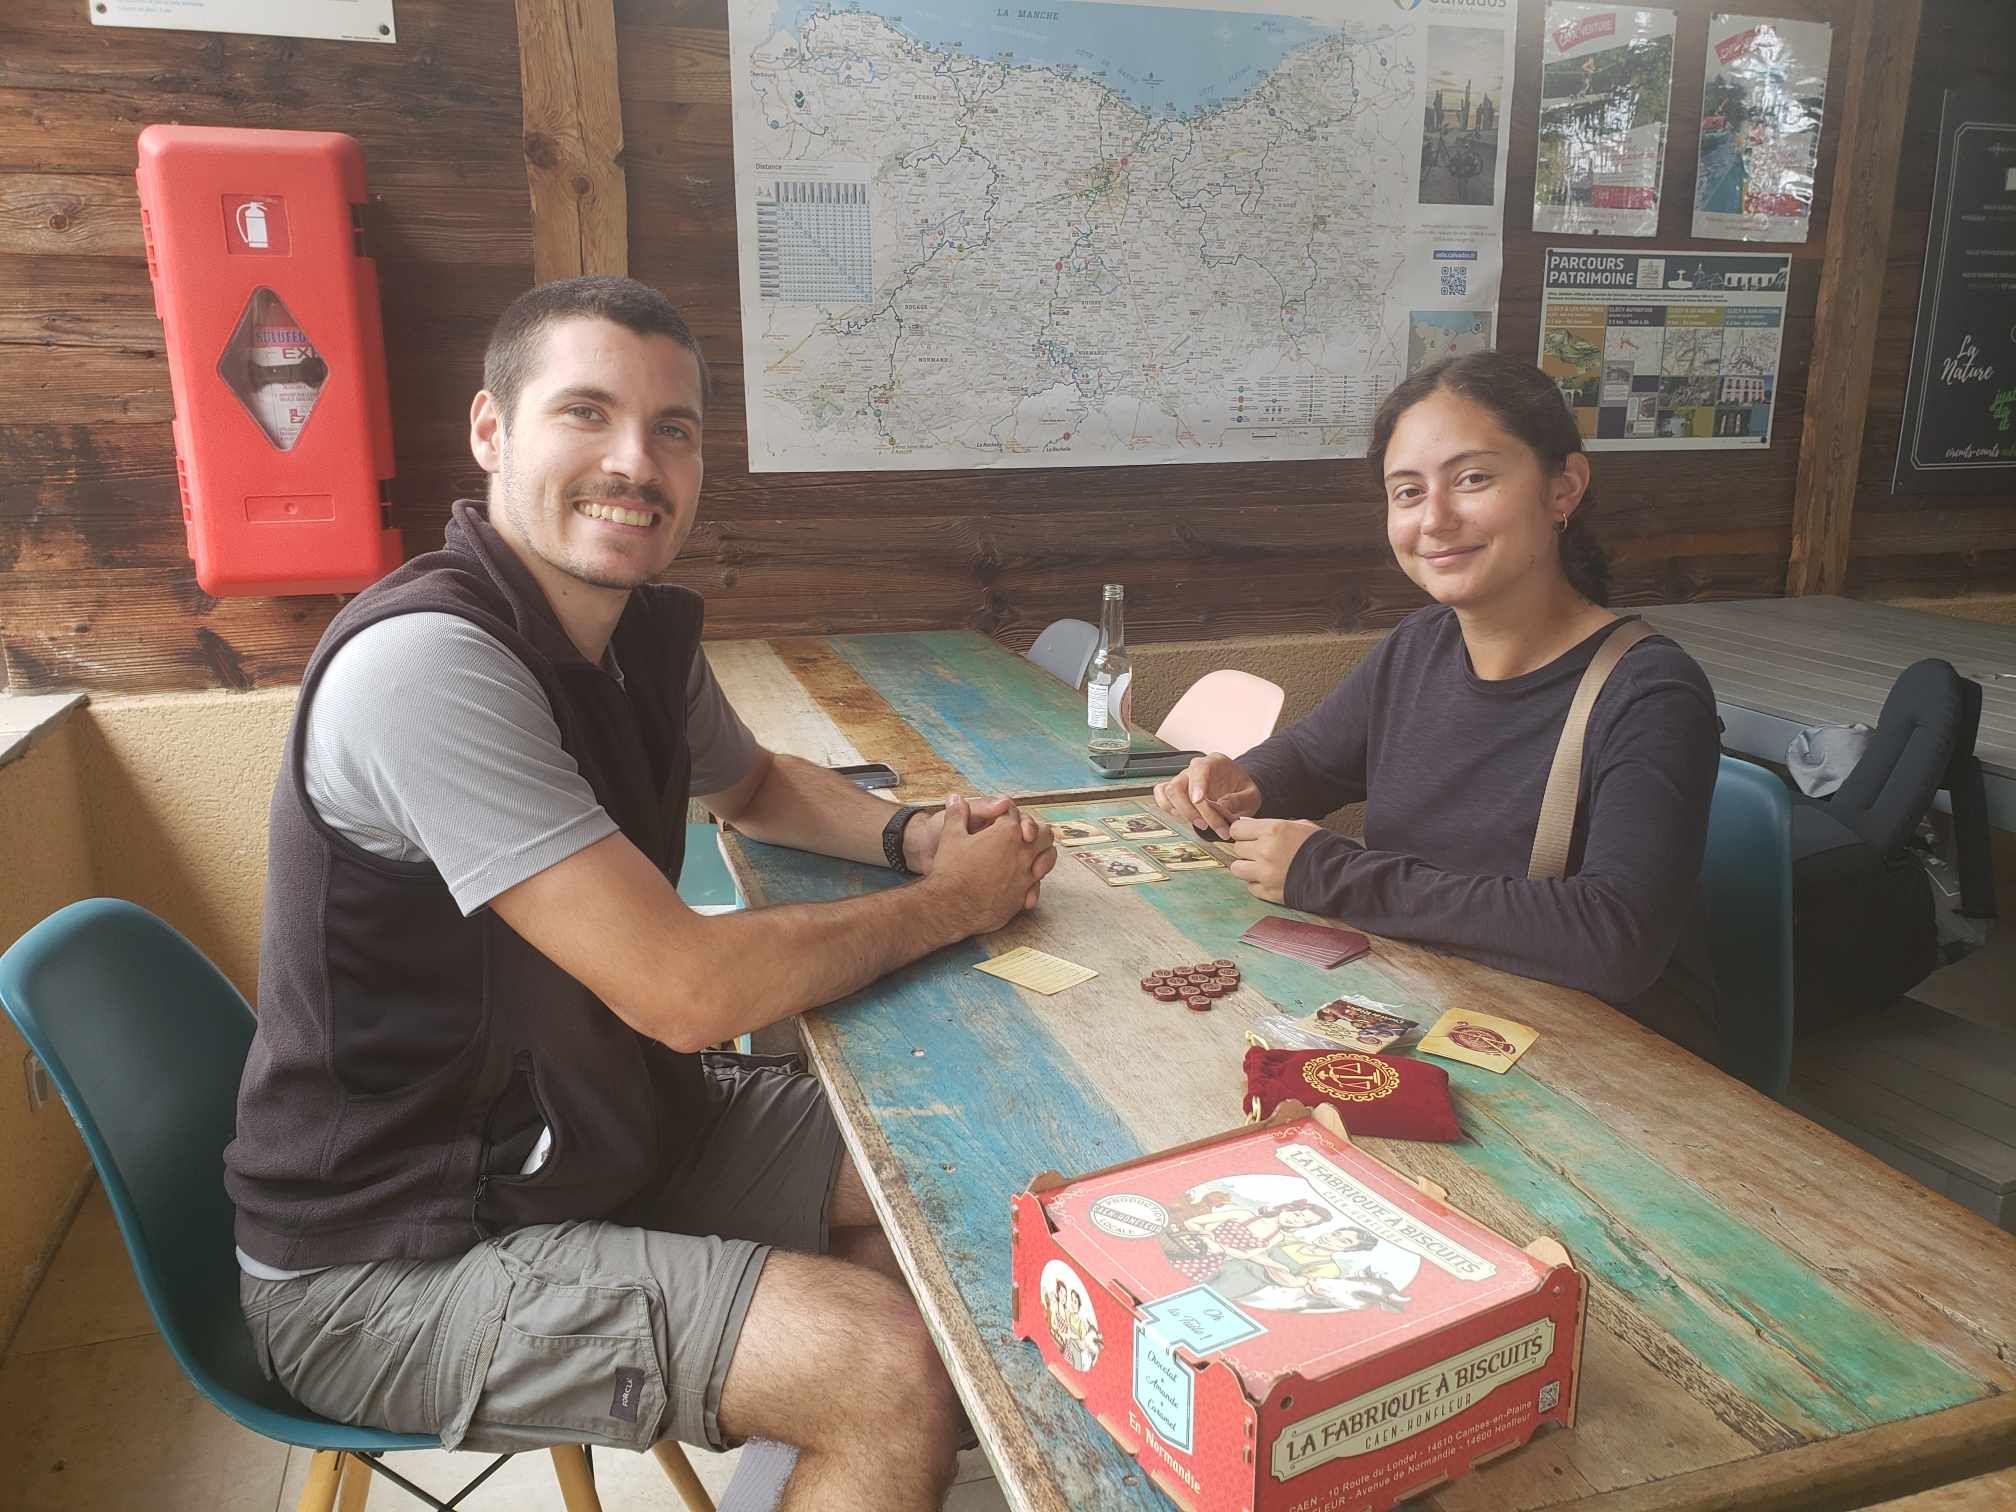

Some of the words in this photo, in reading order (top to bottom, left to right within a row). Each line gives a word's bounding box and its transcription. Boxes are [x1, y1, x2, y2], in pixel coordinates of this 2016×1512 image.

[1549, 271, 1634, 286] PATRIMOINE
[1550, 255, 1625, 271] PARCOURS
[1957, 334, 1980, 359] La
[1941, 357, 1994, 386] Nature
[1290, 1151, 1311, 1168] LA
[1311, 1166, 1391, 1221] FABRIQUE
[1399, 1222, 1480, 1274] BISCUITS
[1146, 1376, 1179, 1408] Amande
[1286, 1431, 1316, 1463] LA
[1321, 1380, 1432, 1448] FABRIQUE
[1435, 1373, 1450, 1398] À
[1455, 1335, 1543, 1389] BISCUITS
[1147, 1398, 1177, 1432] Caramel
[1128, 1409, 1141, 1435] En
[1145, 1427, 1200, 1495] Normandie
[1289, 1496, 1318, 1512] CAEN
[1329, 1486, 1340, 1498] 10
[1342, 1474, 1370, 1492] Route
[1373, 1466, 1384, 1479] du
[1387, 1451, 1418, 1472] Londel
[1427, 1435, 1453, 1454] 14610
[1455, 1400, 1532, 1440] Cambes-en-Plaine
[1356, 1477, 1390, 1499] Avenue
[1393, 1469, 1405, 1481] de
[1408, 1446, 1457, 1474] Normandie
[1466, 1431, 1492, 1448] 14600
[1494, 1413, 1530, 1433] Honfleur
